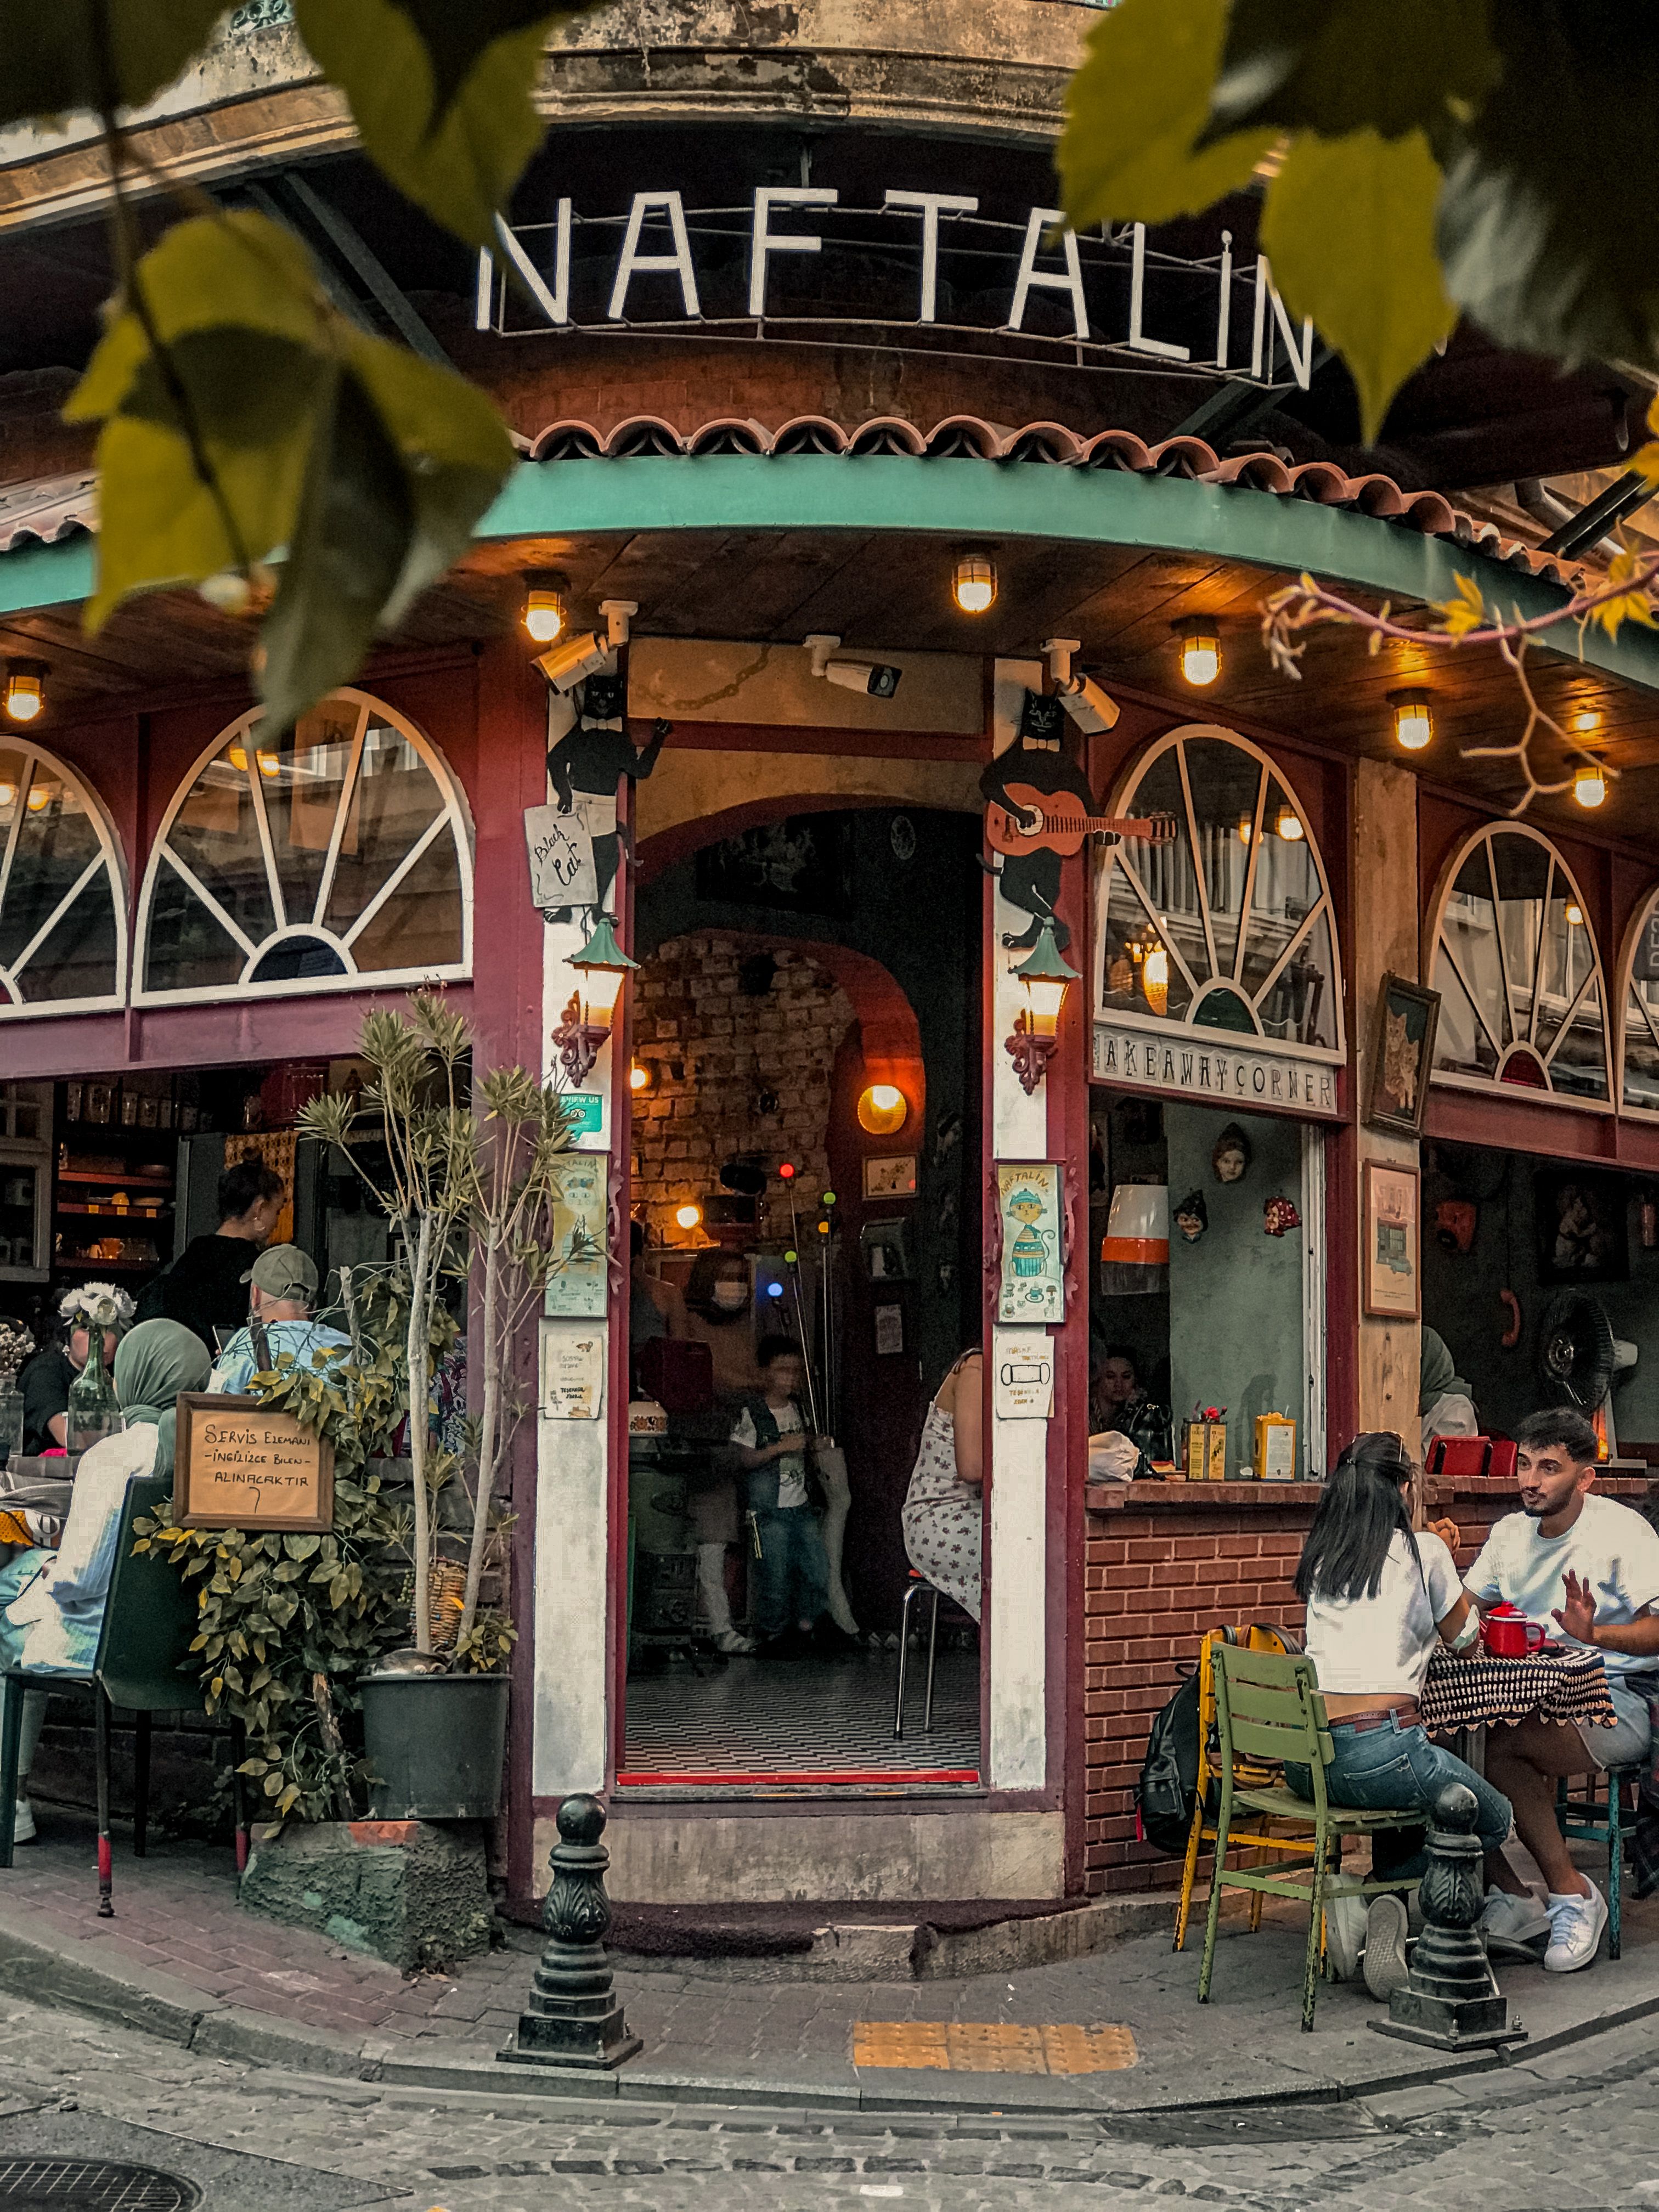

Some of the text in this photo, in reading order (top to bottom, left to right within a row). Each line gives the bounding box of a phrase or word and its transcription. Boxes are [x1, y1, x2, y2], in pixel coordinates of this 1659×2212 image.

[476, 186, 1313, 390] NAFTALİN
[534, 823, 570, 867] Black
[552, 842, 582, 886] Cat
[205, 1424, 310, 1446] SERVİS ELEMANI
[215, 1471, 308, 1486] ALINACAKTIR
